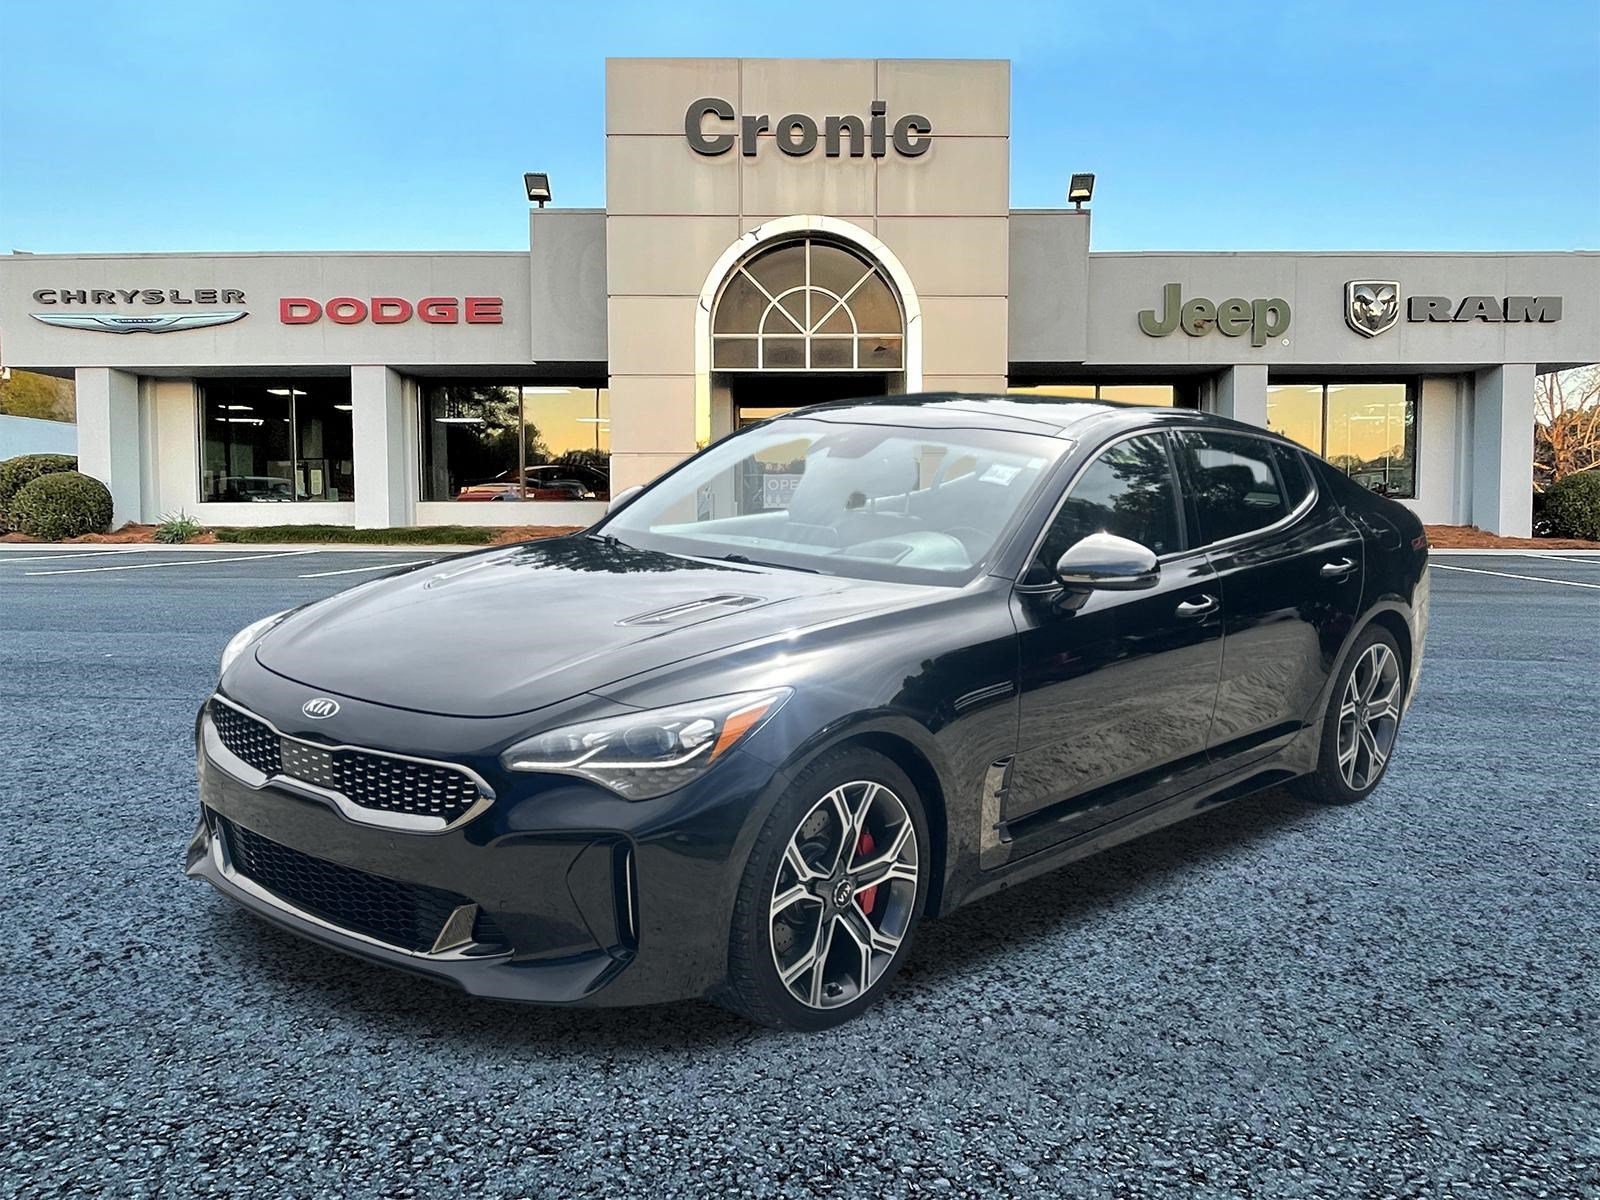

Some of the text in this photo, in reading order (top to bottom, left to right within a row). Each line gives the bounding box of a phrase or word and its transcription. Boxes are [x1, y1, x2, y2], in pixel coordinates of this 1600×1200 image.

[685, 97, 932, 157] Cronic
[32, 289, 246, 304] CHRYSLER
[1407, 296, 1563, 322] RAM
[280, 297, 503, 324] DODGE
[1138, 283, 1291, 347] Jeep
[767, 479, 803, 490] OPE
[305, 700, 332, 715] KIA
